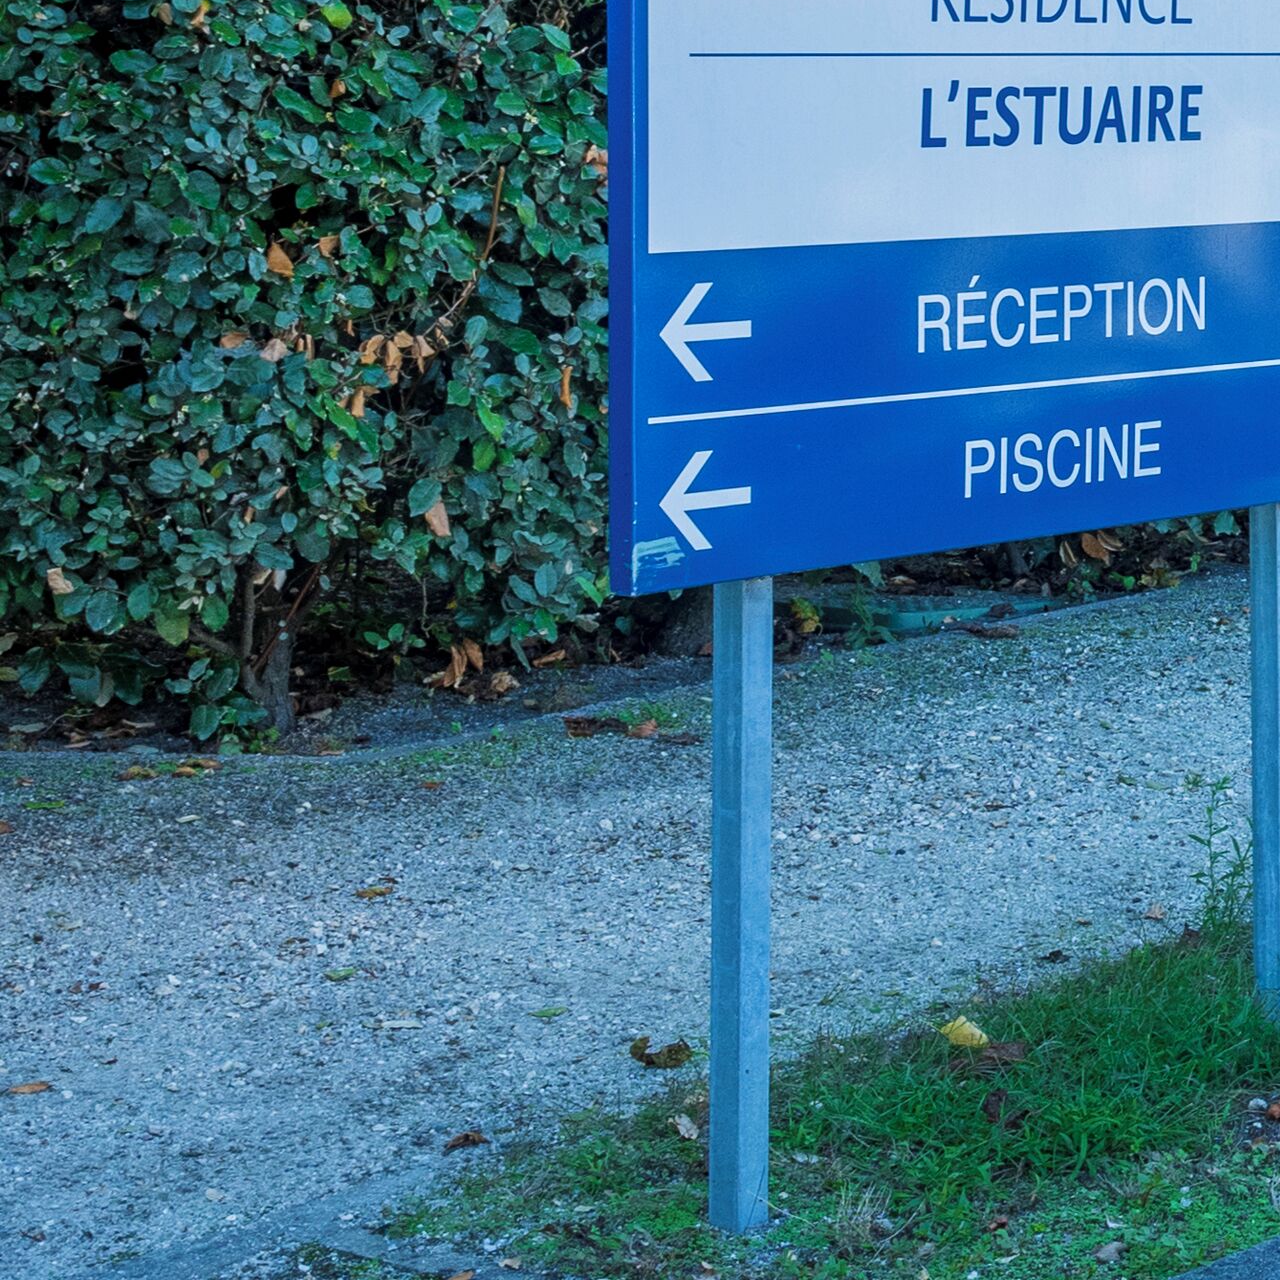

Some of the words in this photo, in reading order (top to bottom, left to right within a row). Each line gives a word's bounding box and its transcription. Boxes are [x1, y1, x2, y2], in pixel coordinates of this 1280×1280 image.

[920, 79, 1204, 149] L'ESTUAIRE
[917, 274, 1206, 354] RÉCEPTION
[964, 420, 1162, 499] PISCINE
